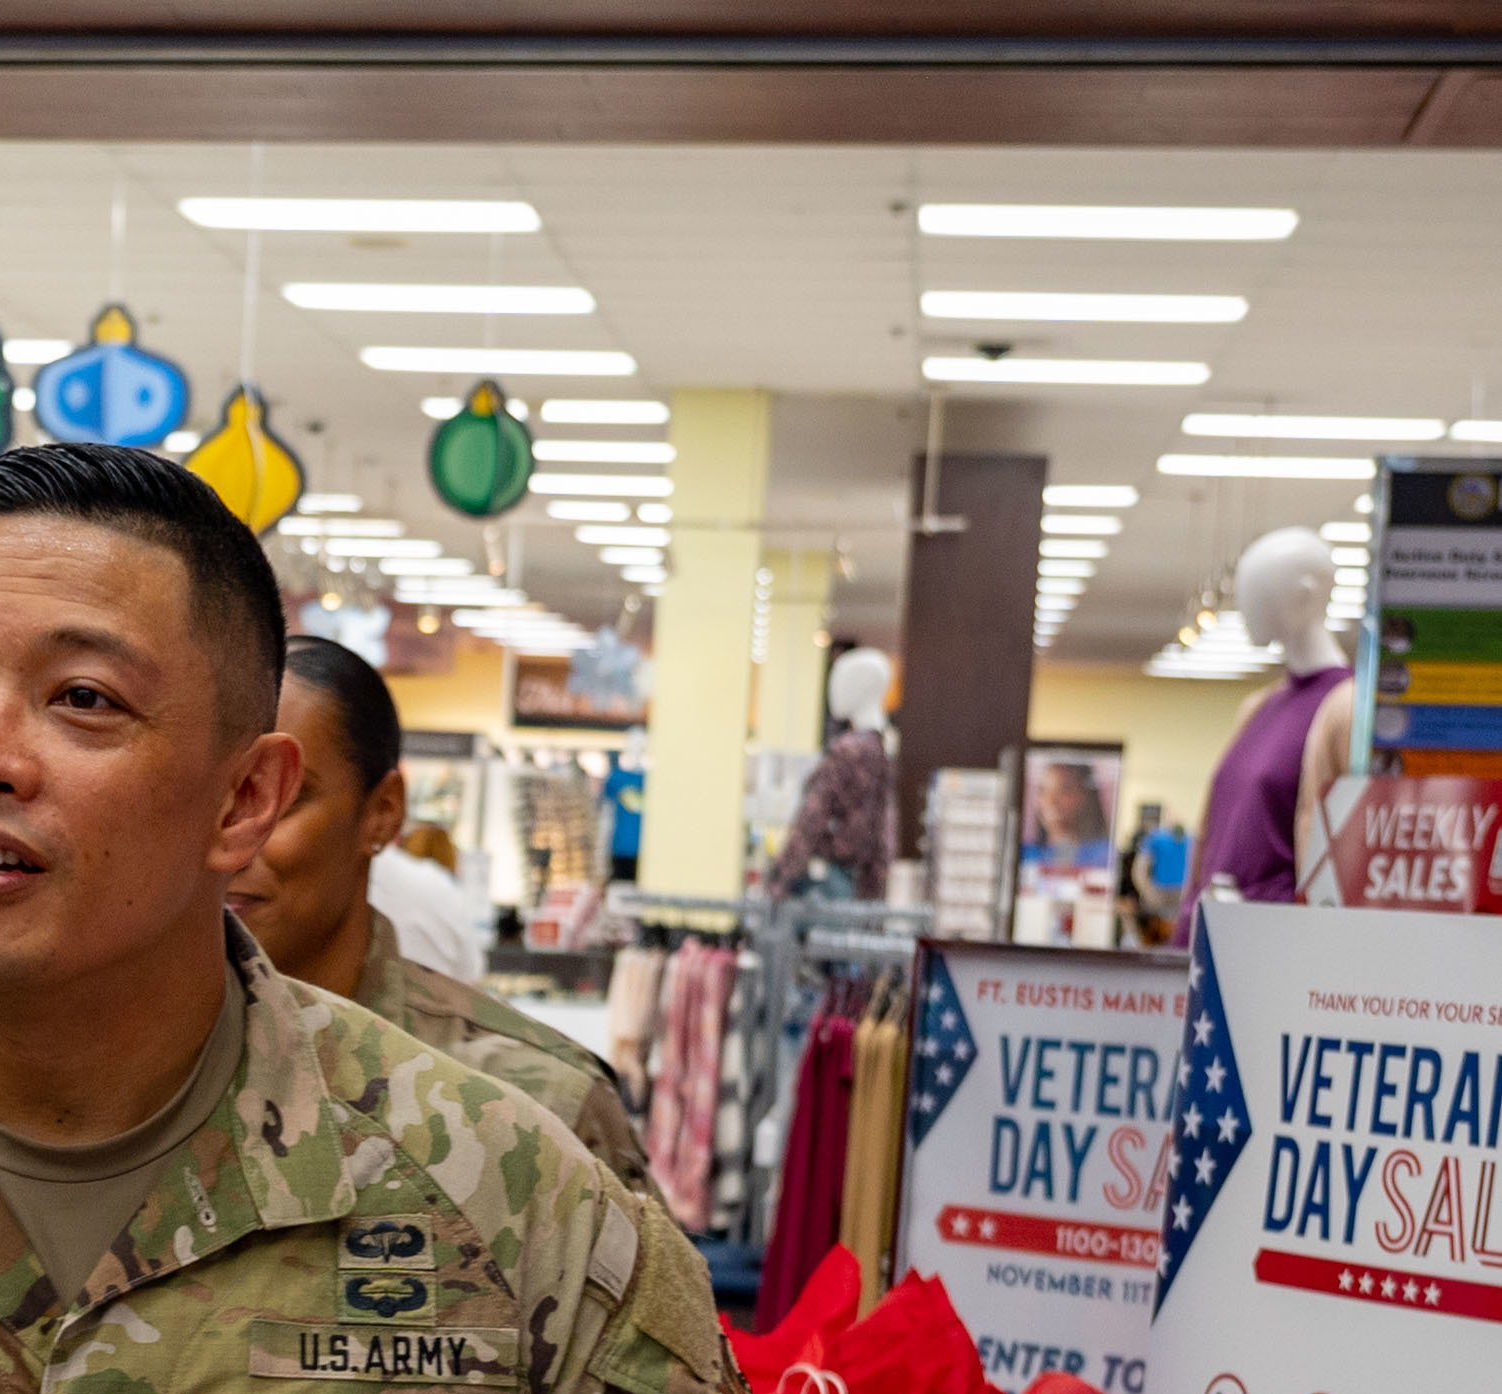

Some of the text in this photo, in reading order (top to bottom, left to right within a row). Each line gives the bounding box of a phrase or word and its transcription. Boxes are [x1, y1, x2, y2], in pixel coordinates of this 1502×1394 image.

[1364, 803, 1496, 851] WEEKLY
[1363, 854, 1472, 901] SALES
[976, 979, 1007, 1003] FT.
[1015, 982, 1094, 1011] EUSTIS
[1102, 991, 1164, 1017] MAIN
[1308, 990, 1356, 1013] THANK
[1361, 995, 1394, 1017] YOU
[1397, 999, 1430, 1019] FOR
[1434, 1001, 1484, 1024] YOUR
[989, 1114, 1099, 1204] DAY
[1263, 1133, 1378, 1246] DAY
[986, 1264, 1112, 1302] NOVEMBER
[300, 1332, 466, 1377] U.S. ARMY
